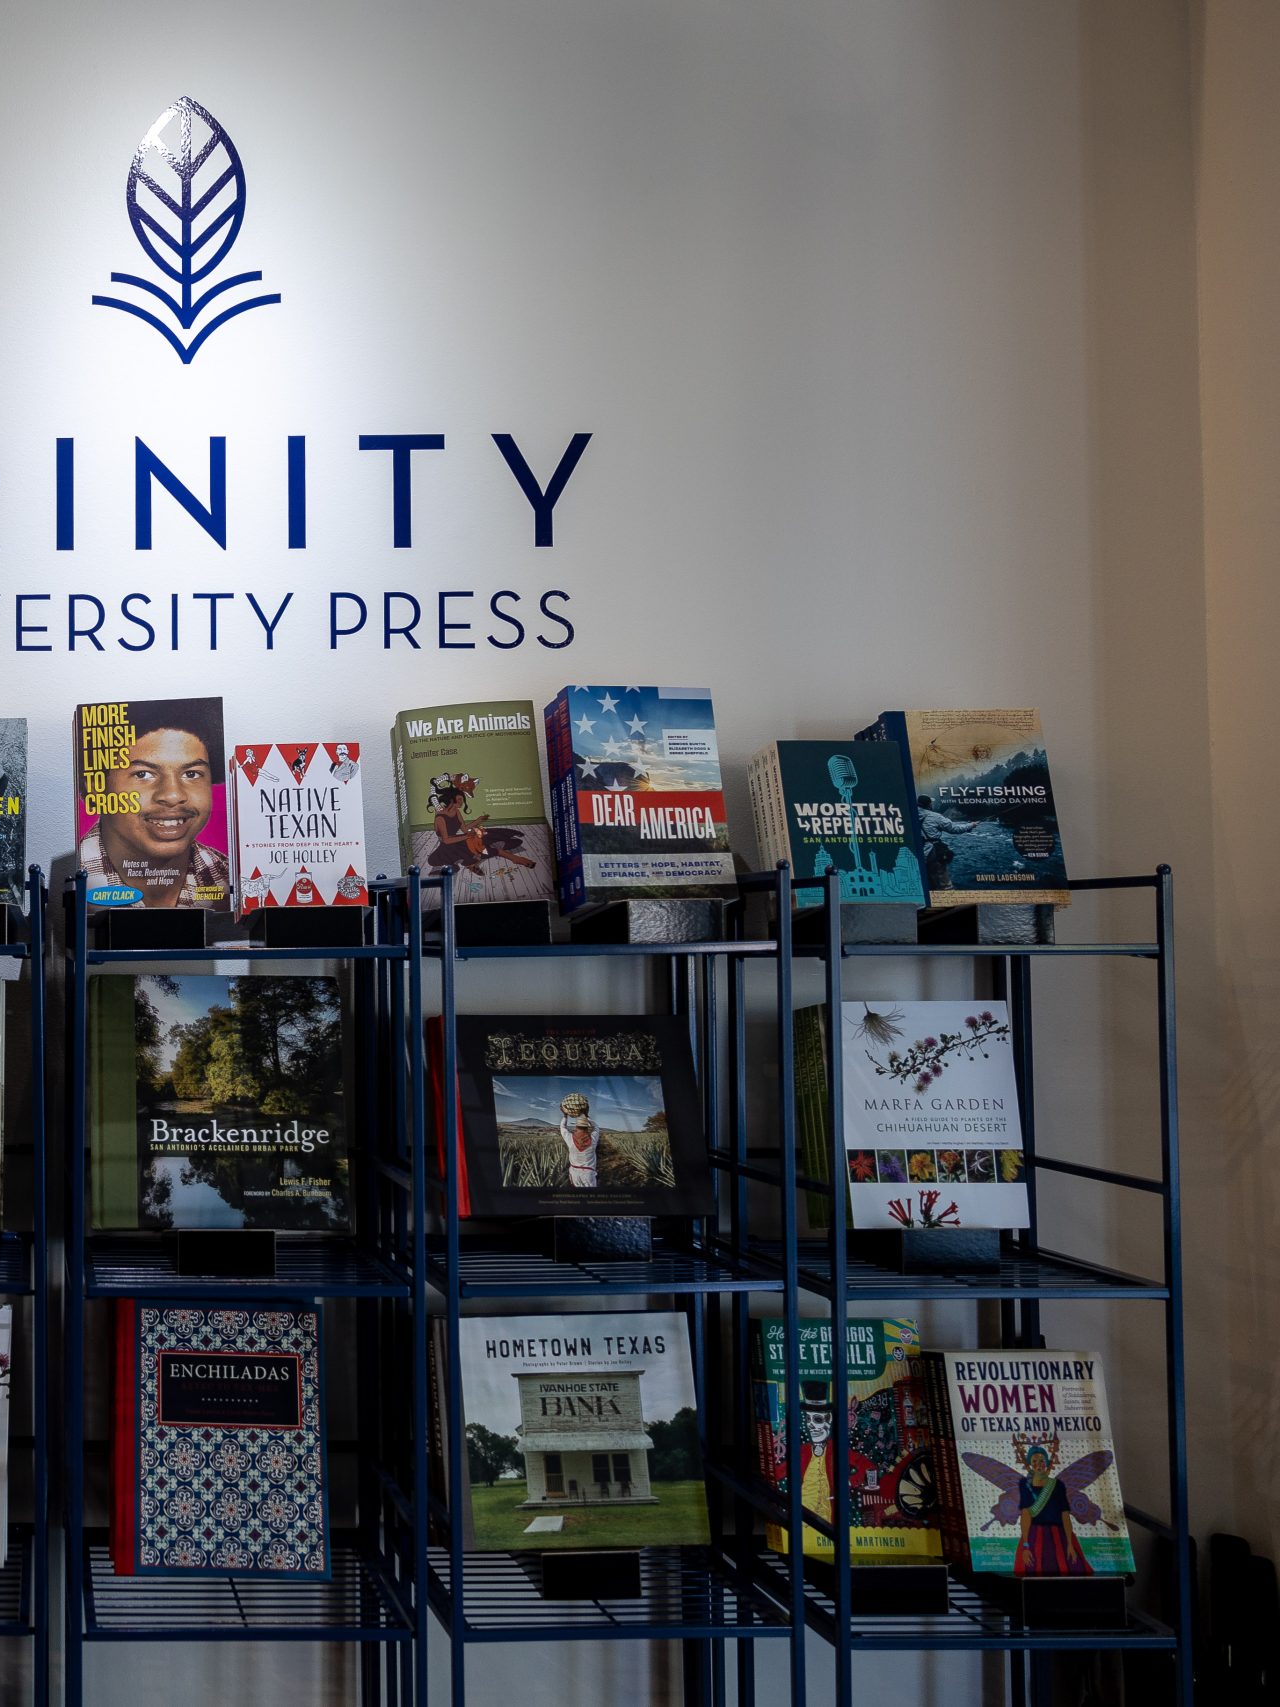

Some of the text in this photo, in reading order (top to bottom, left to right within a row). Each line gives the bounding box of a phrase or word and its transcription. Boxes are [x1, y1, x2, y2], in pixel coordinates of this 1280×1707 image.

[329, 590, 576, 650] PRESS
[82, 703, 129, 727] MORE
[405, 712, 531, 738] We Are Animals
[82, 725, 136, 749] FINISH
[83, 747, 131, 771] LINES
[410, 748, 458, 760] Jennifer Case
[84, 771, 106, 793] TO
[939, 785, 1046, 797] FLY-FISHING
[85, 791, 141, 815] CROSS
[260, 786, 341, 813] NATIVE
[592, 794, 717, 840] DEAR AMERICA
[793, 802, 887, 816] WORTH
[265, 813, 337, 839] TEXAN
[811, 817, 905, 835] REPEATING
[122, 859, 139, 868] Notes
[269, 849, 337, 864] JOE HOLLEY
[651, 861, 679, 869] HOPE,
[681, 860, 723, 868] HABITAT,
[127, 867, 181, 877] Race, Redemption,
[601, 871, 650, 879] DEFIANCE,
[976, 873, 1035, 882] DAVID LADENSOHN
[146, 877, 174, 887] and Hope
[93, 891, 135, 901] CARY CLACK
[204, 892, 225, 900] HOLLEY
[488, 1035, 644, 1065] TEQUILA
[864, 1098, 1004, 1111] MARFA GARDEN
[150, 1119, 330, 1152] Brackenridge
[876, 1123, 1007, 1132] CHIHUAHUAN DESERT
[166, 1143, 205, 1151] ANTONIO'S
[252, 1144, 277, 1152] URBAN
[279, 1177, 331, 1186] Lewis Fisher
[271, 1189, 294, 1197] Charles
[486, 1335, 666, 1358] HOMETOWN TEXAS
[170, 1363, 290, 1381] ENCHILADAS
[954, 1361, 1094, 1381] REVOLUTIONARY
[539, 1382, 620, 1393] IVANHOE STATE
[540, 1395, 622, 1416] BANK
[957, 1383, 1057, 1414] WOMEN
[961, 1415, 1102, 1432] OF TEXAS AND MEXICO
[856, 1536, 905, 1547] MARTINEAU
